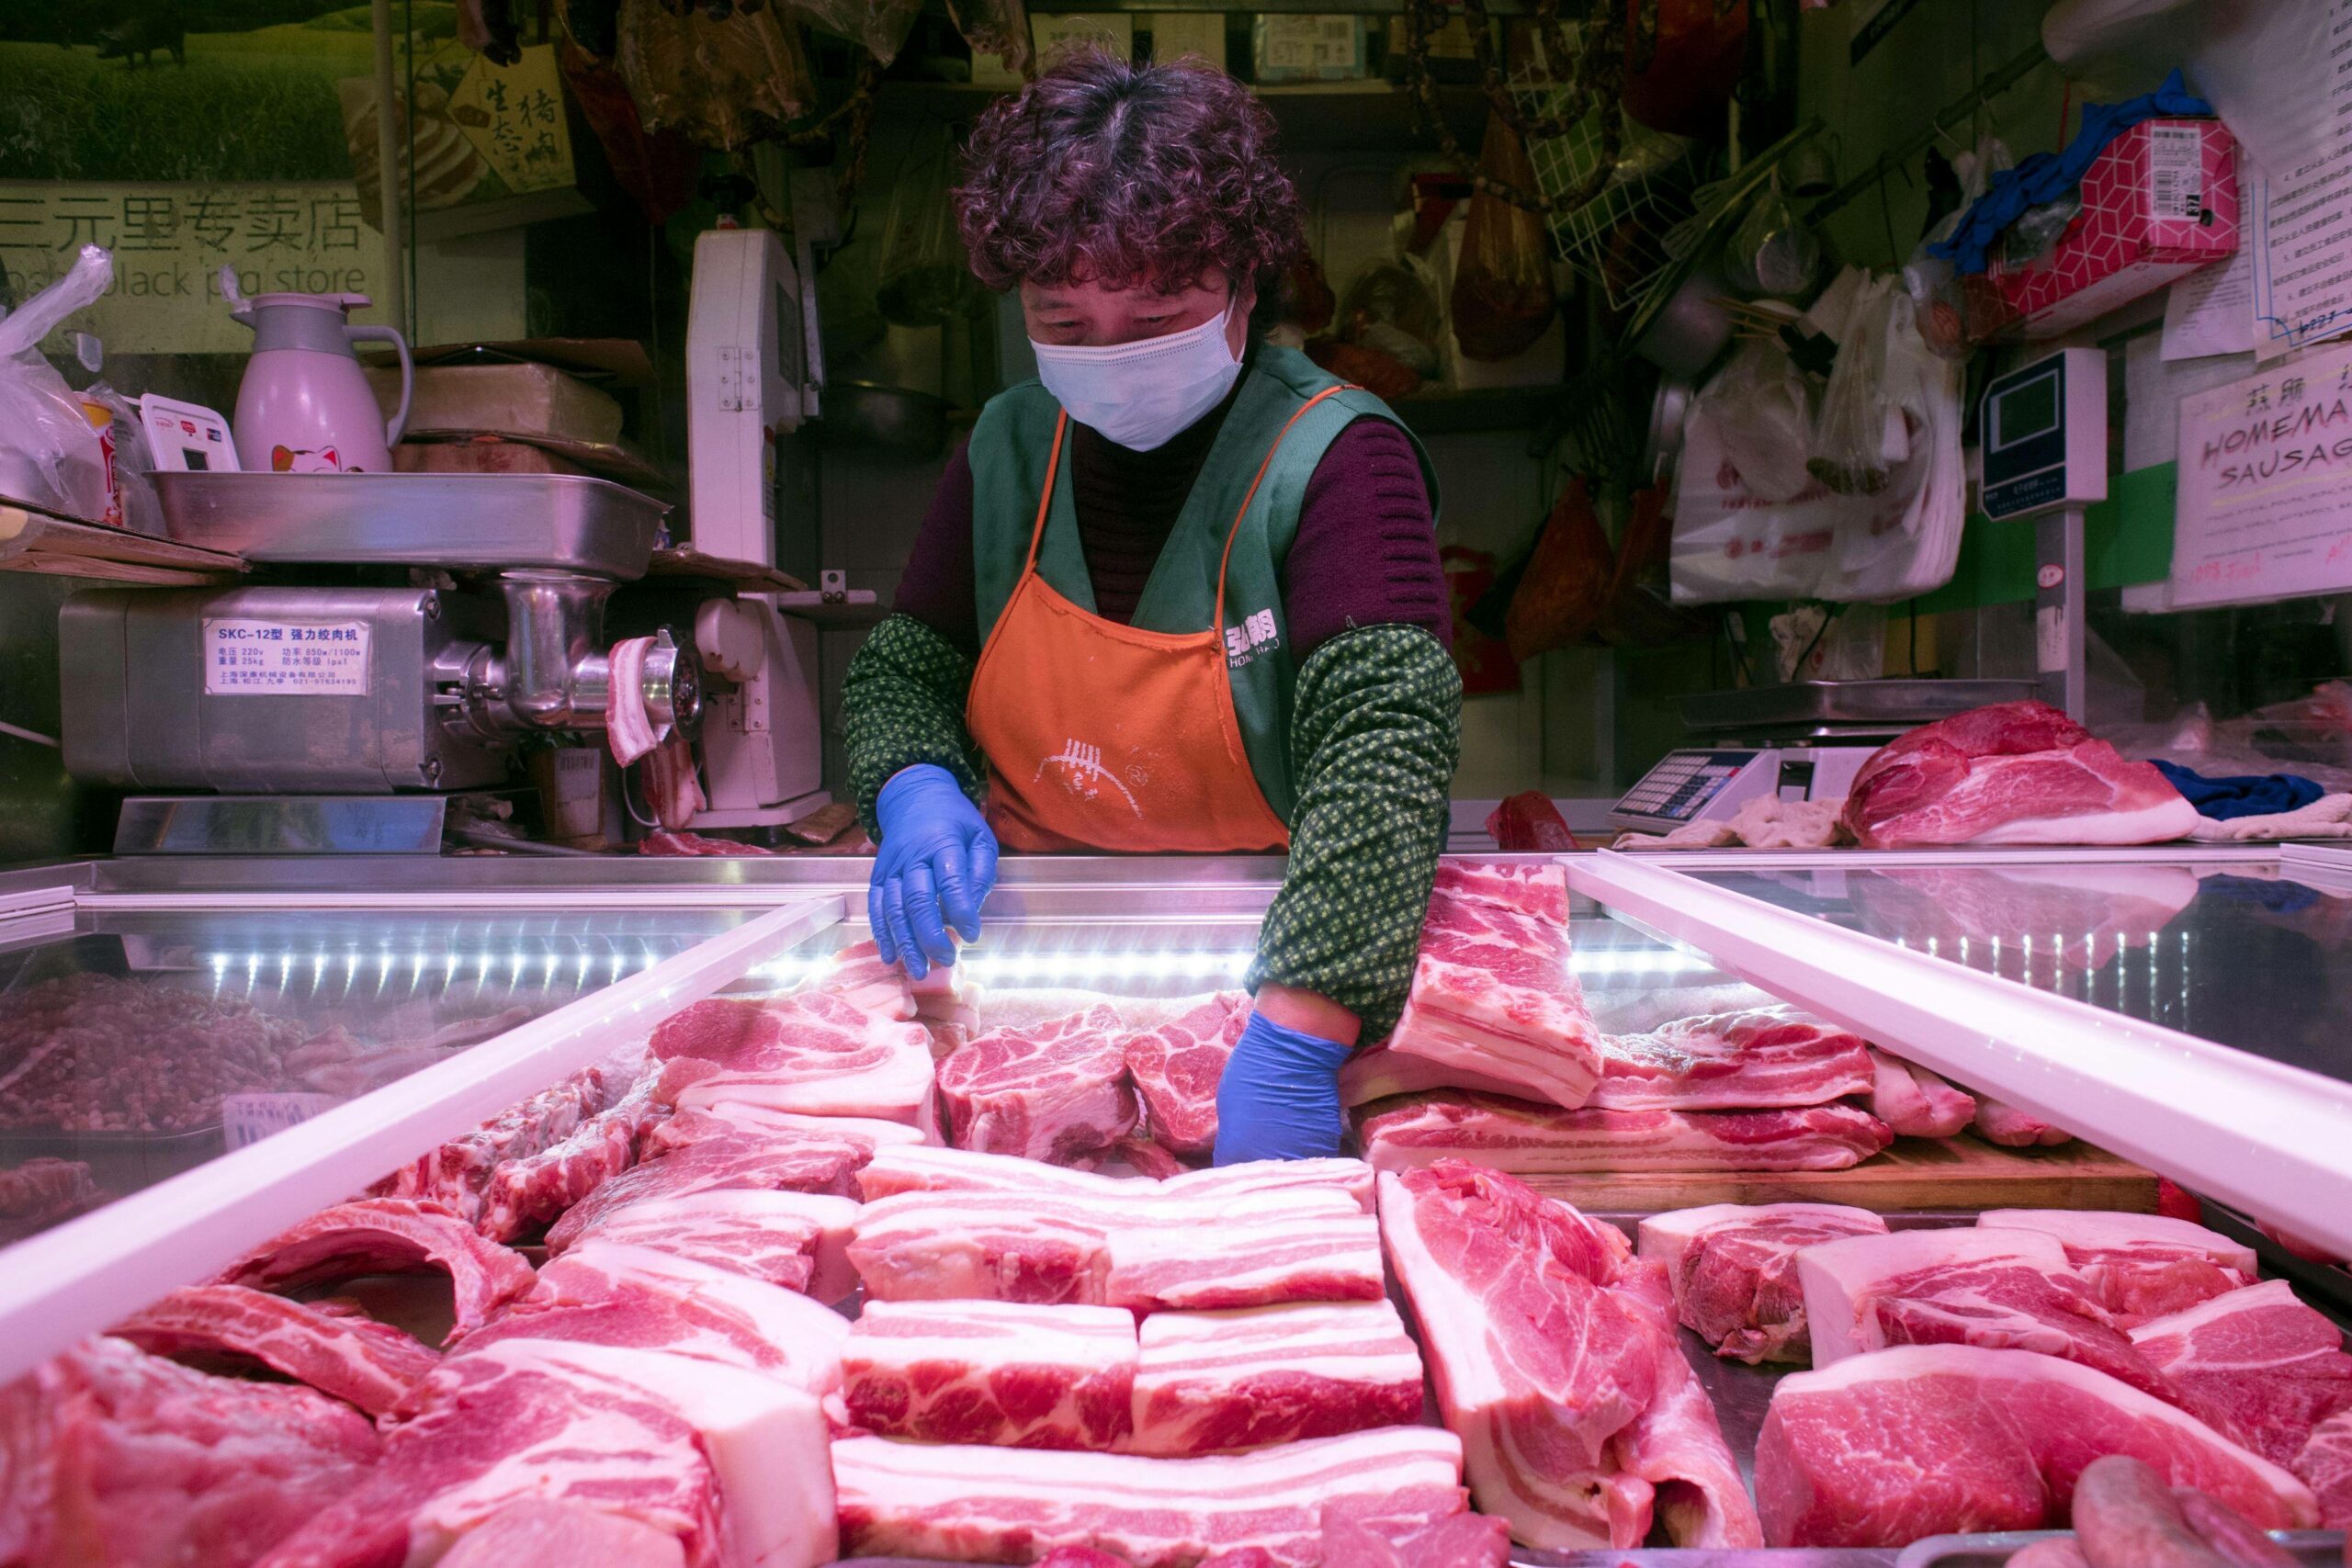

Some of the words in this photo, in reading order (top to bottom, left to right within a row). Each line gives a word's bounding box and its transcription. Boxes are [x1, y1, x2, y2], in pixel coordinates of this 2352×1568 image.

[0, 193, 364, 253] 三元里专卖店
[206, 267, 261, 304] pg
[277, 265, 366, 295] store
[219, 628, 283, 640] SKC-12型
[291, 628, 358, 641] 强力绞肉机
[219, 647, 237, 656] 电压
[282, 647, 301, 656] 功率
[219, 656, 237, 666] 重量
[282, 656, 322, 666] 防水等级
